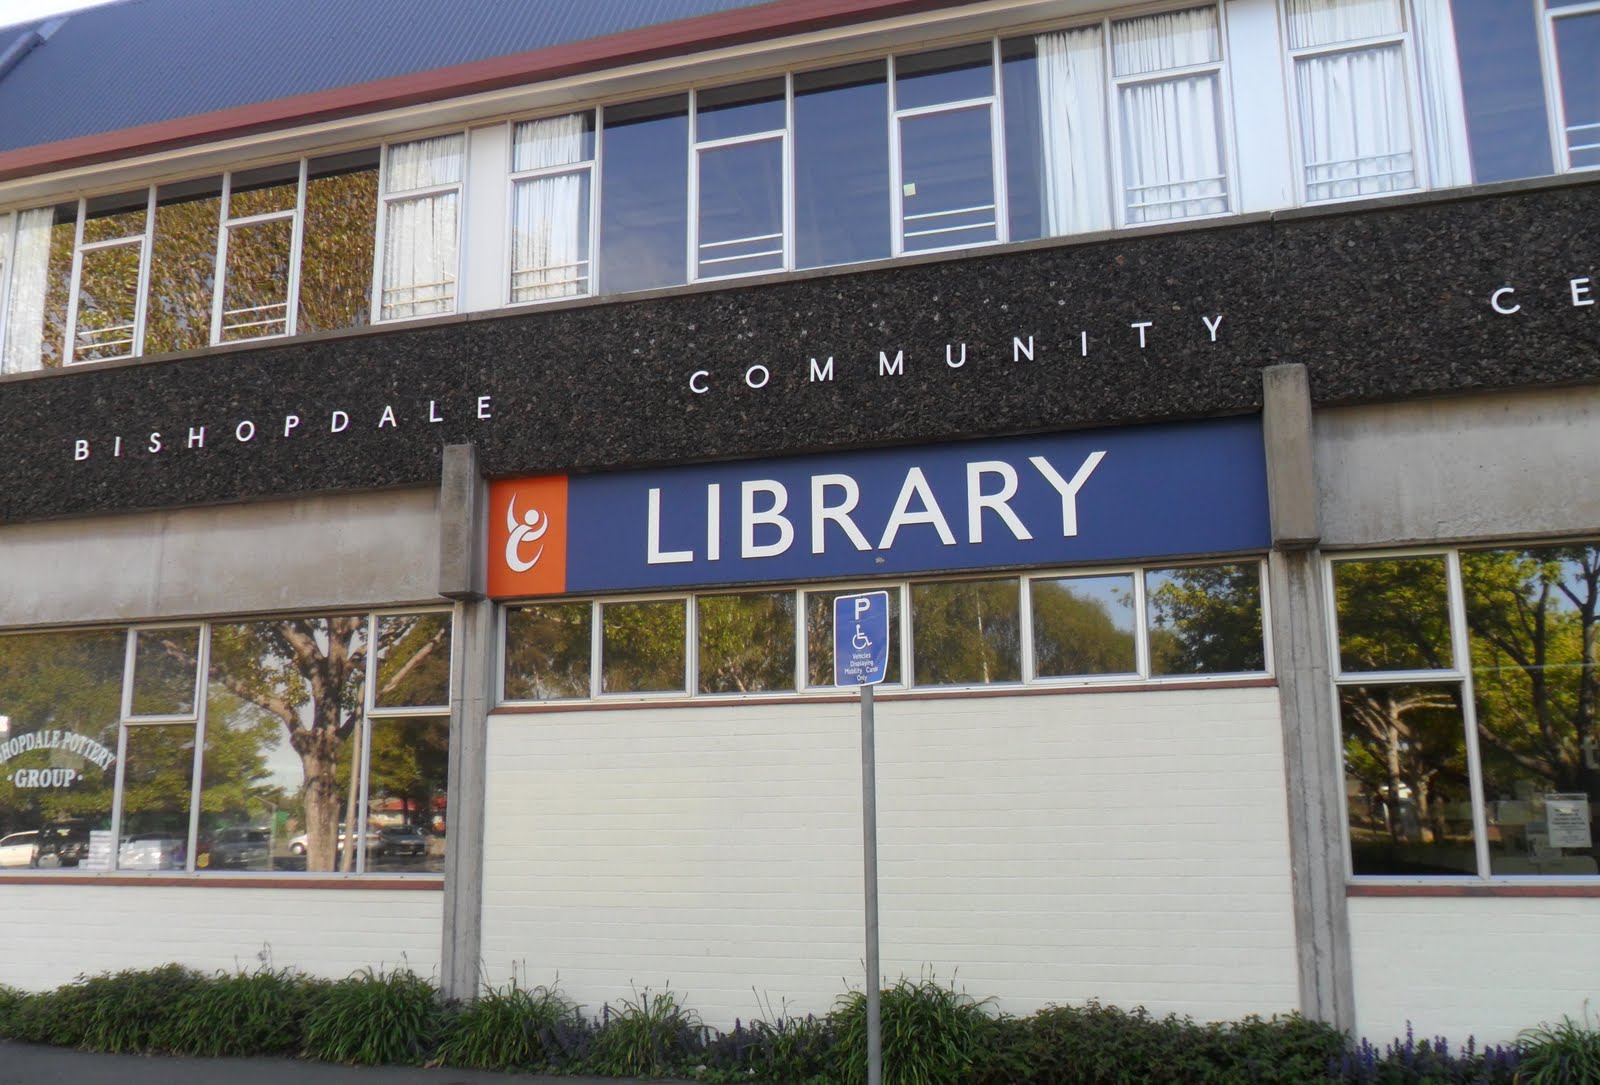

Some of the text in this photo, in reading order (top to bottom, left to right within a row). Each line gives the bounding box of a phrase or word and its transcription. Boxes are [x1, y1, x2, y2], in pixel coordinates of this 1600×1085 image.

[74, 277, 1595, 461] BISHOPDALE COMMUNITY CE
[647, 450, 1107, 564] LIBRARY
[854, 597, 871, 620] P
[852, 652, 871, 660] Vehicles
[856, 674, 868, 682] Only
[61, 731, 117, 771] POTTERY
